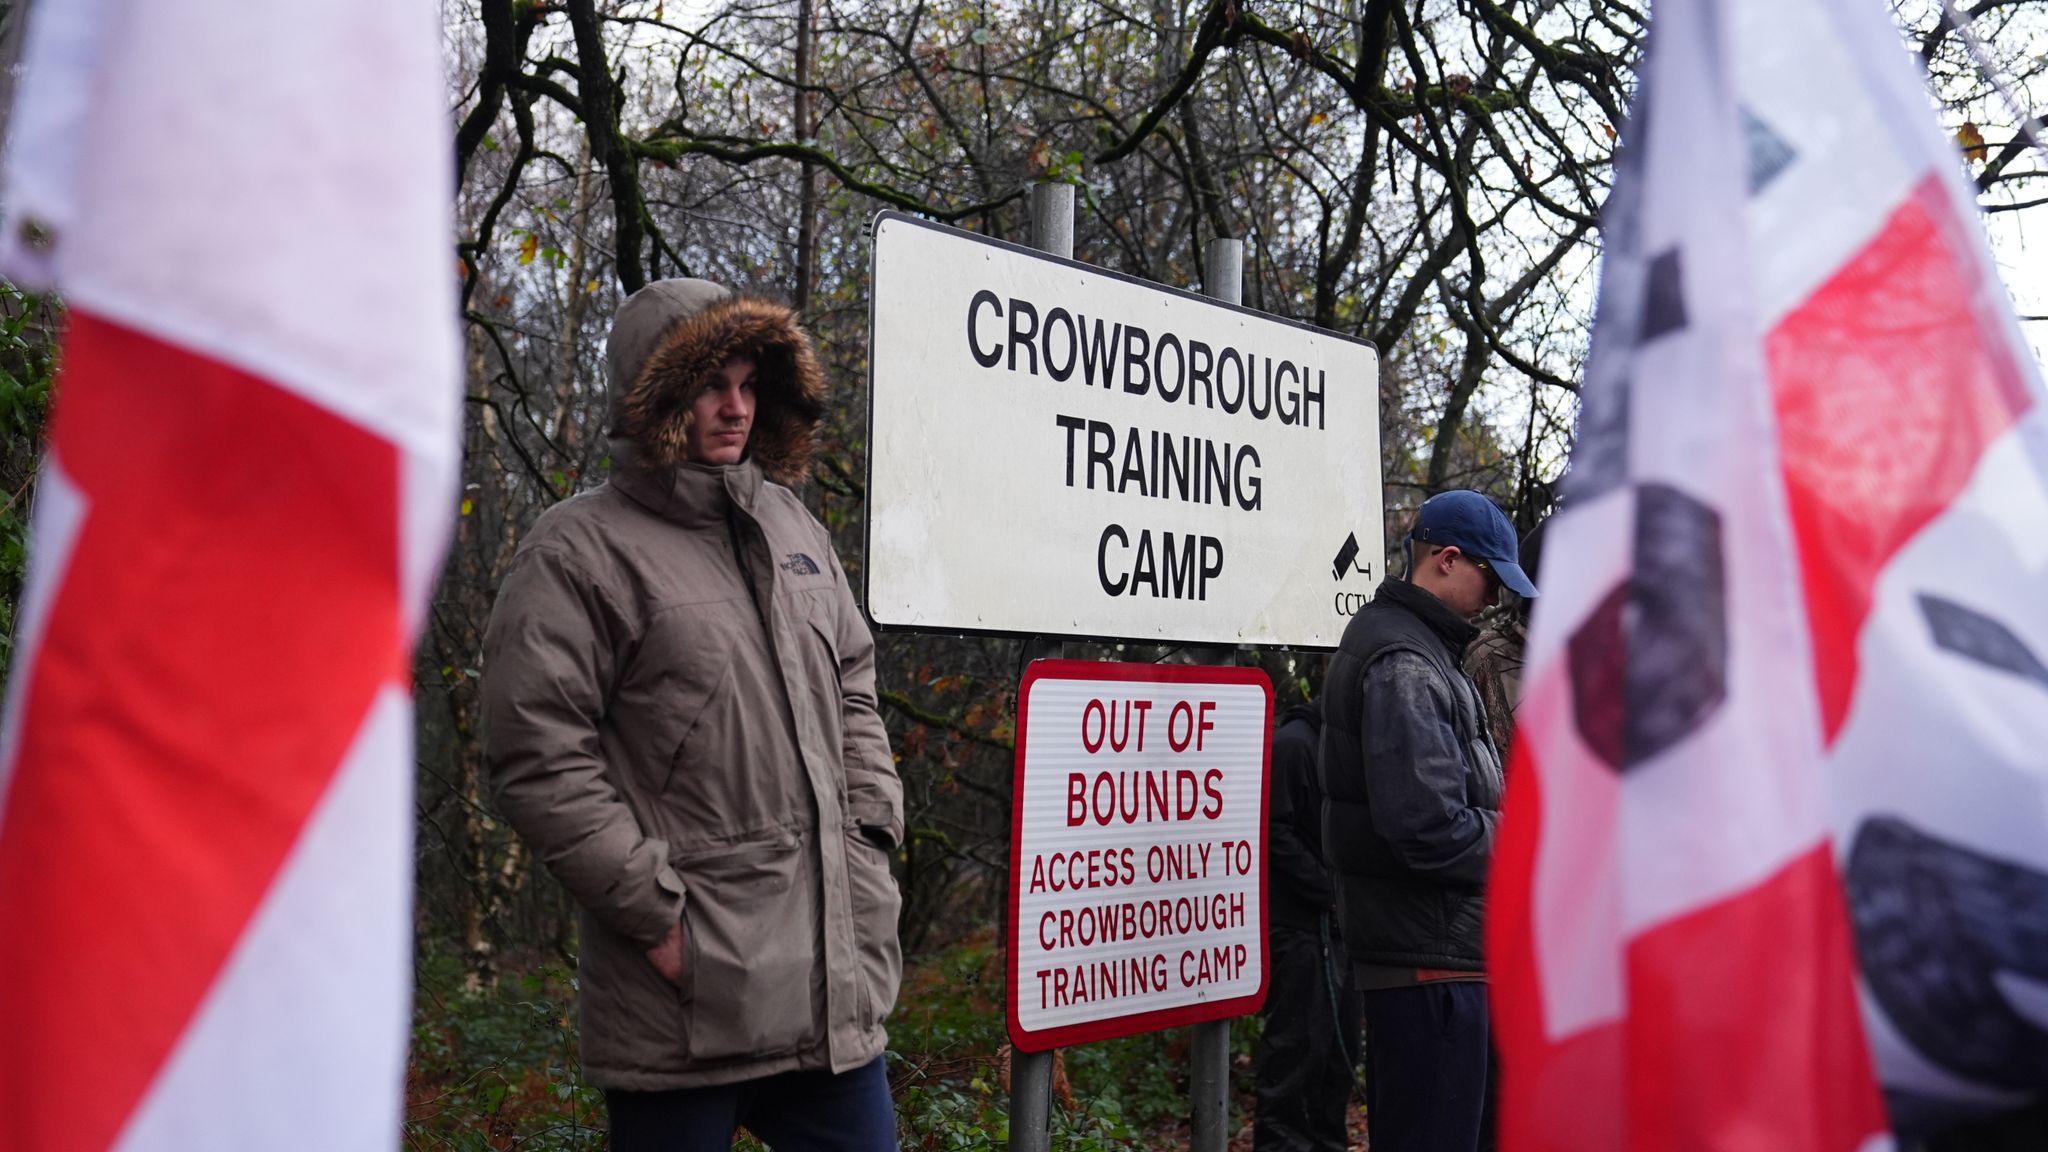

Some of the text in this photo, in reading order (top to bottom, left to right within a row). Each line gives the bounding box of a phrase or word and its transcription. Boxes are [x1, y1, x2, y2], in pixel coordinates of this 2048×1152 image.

[967, 289, 1325, 430] CROWBOROUGH
[1056, 414, 1261, 511] TRAINING
[1098, 525, 1224, 601] CAMP
[1082, 699, 1216, 753] OUT OF
[1067, 769, 1223, 826] BOUNDS
[1030, 840, 1251, 894] ACCESS ONLY TO
[1039, 892, 1244, 950] CROWBOROUGH
[1037, 944, 1246, 1009] TRAINING CAMP
